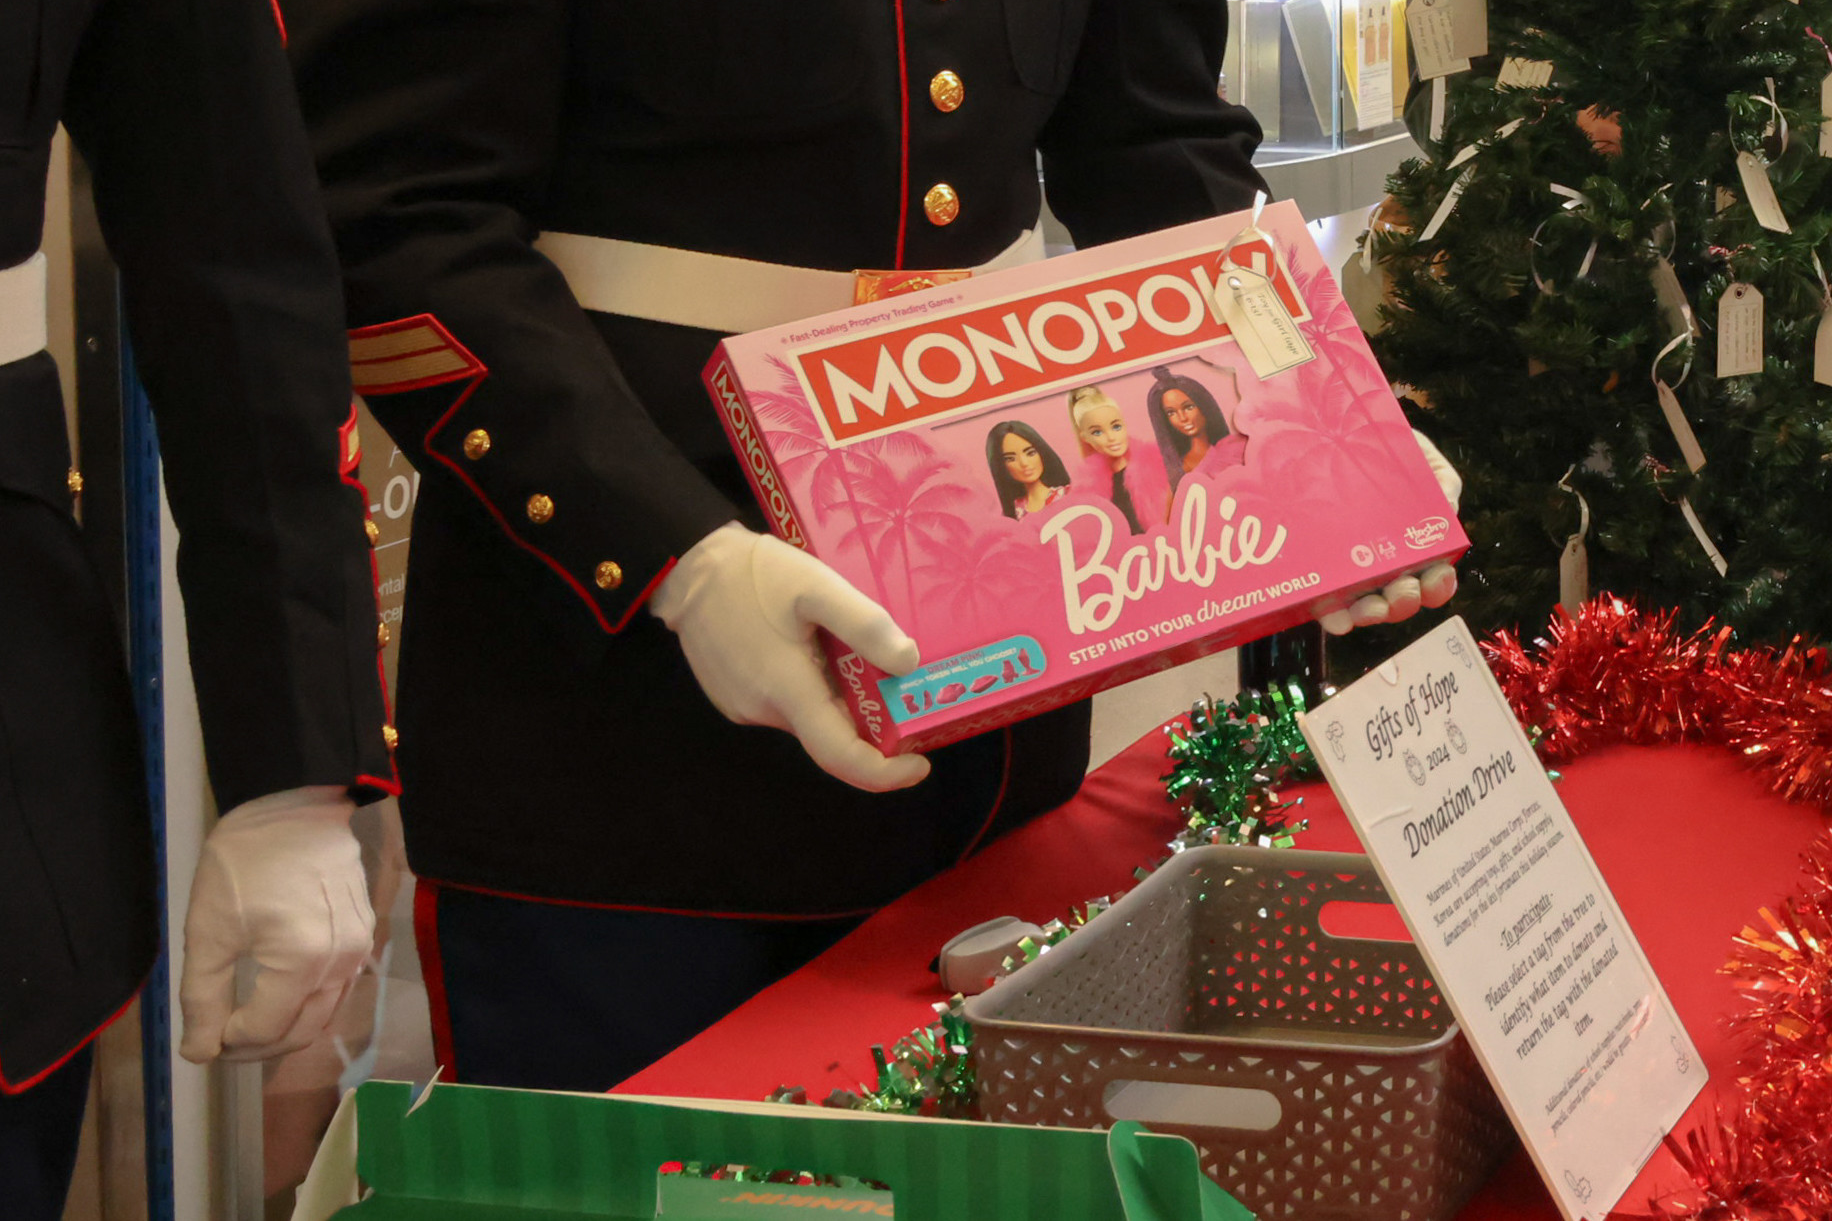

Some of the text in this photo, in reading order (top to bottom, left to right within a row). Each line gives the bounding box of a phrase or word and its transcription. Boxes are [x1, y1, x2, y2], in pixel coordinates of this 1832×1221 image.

[790, 296, 955, 343] Fast-Dealing Property Trading Game
[717, 374, 803, 549] MONOPOLY
[1040, 483, 1286, 635] Barbie
[1404, 521, 1446, 540] Hasbro
[1069, 572, 1321, 665] STEP INTO YOUR dream WORLD
[837, 652, 882, 743] Barbie
[1366, 672, 1458, 761] Gifts of Hope
[1426, 743, 1450, 771] 2024
[1403, 751, 1515, 858] Donation Drive
[1426, 815, 1523, 906] Marines of United States Marine Corps
[1433, 906, 1454, 927] Korea
[1453, 896, 1464, 911] are
[1464, 874, 1489, 901] accepting
[1444, 917, 1471, 947] donations
[1469, 909, 1479, 927] for
[1478, 899, 1489, 914] the
[1528, 846, 1549, 866] holiday
[1485, 894, 1595, 1011] Please select a tag from the tree to
[1512, 894, 1552, 945] participate
[1500, 912, 1608, 1036] identify what item to donate and
[1516, 938, 1618, 1059] return the tag with the donated
[1574, 1013, 1593, 1037] item.
